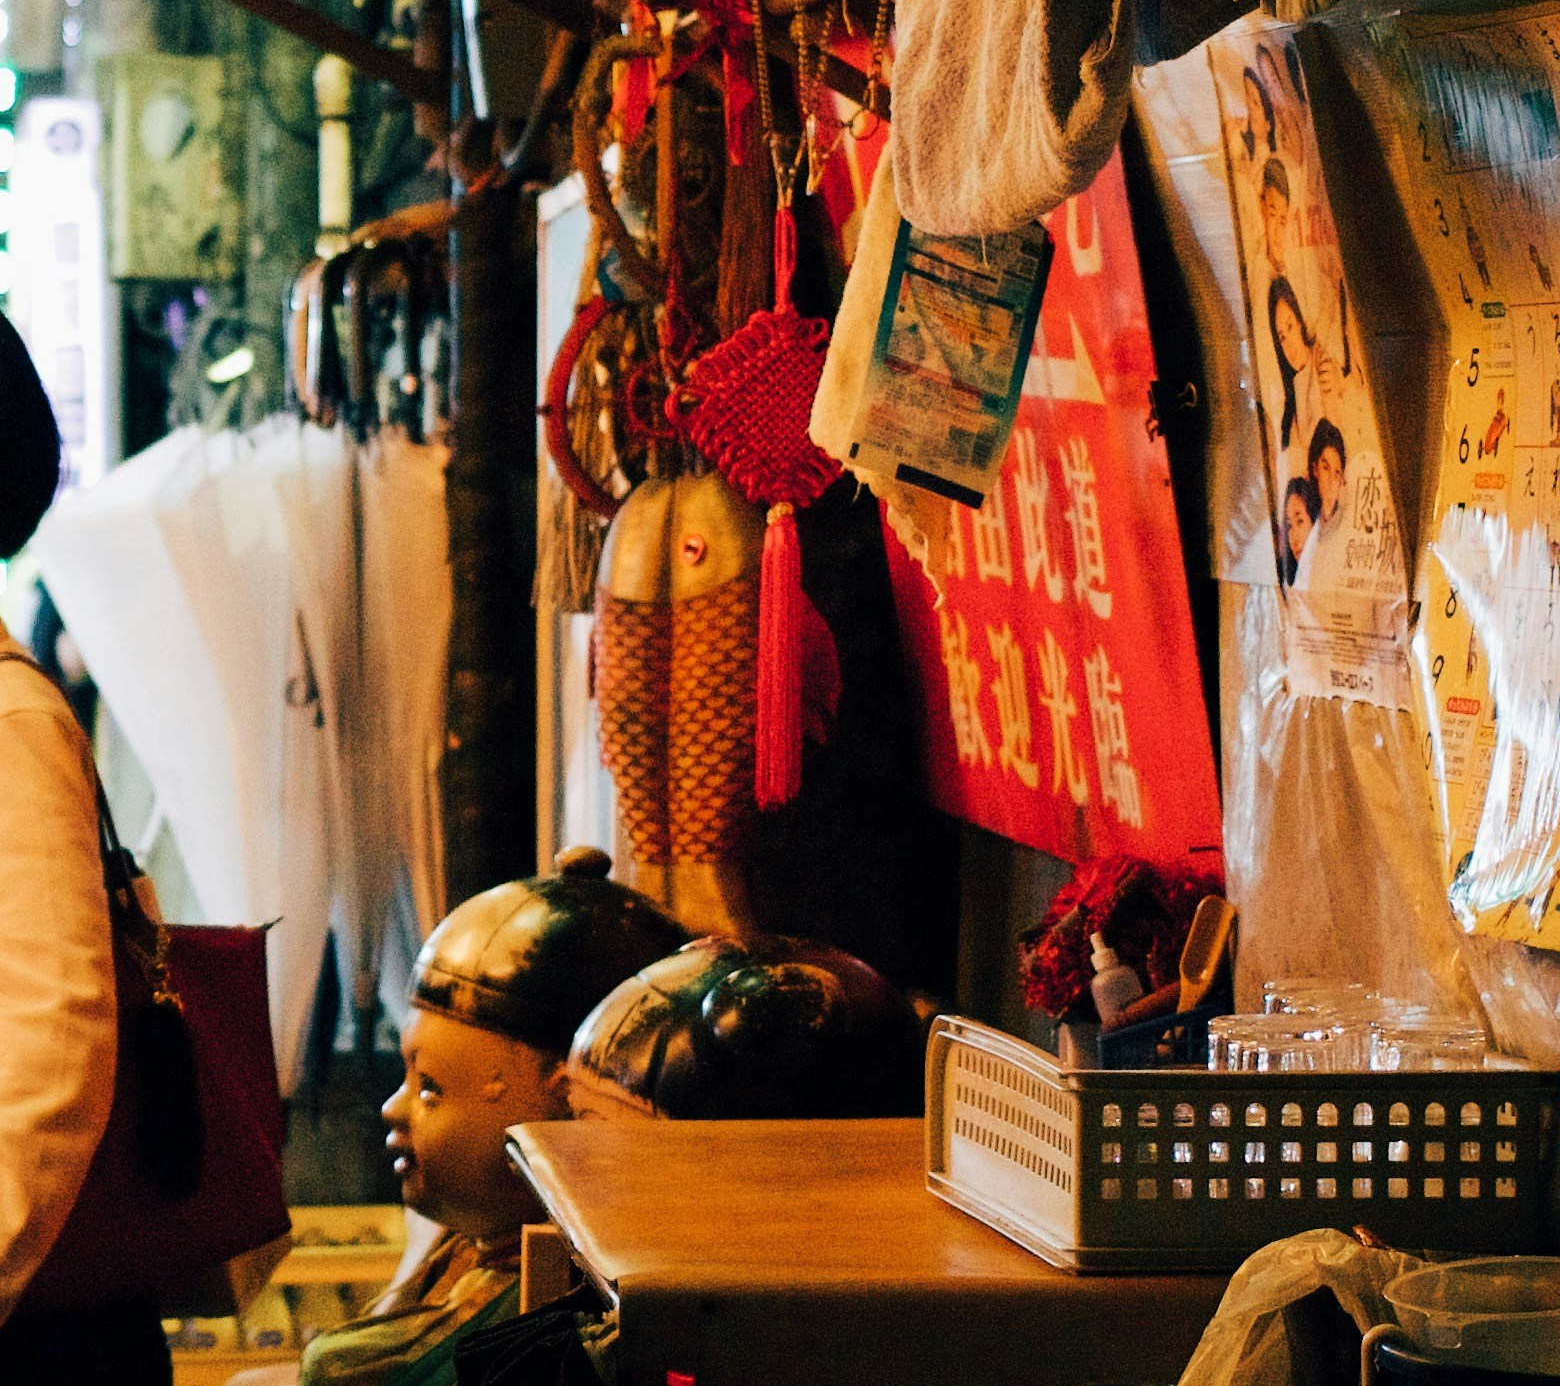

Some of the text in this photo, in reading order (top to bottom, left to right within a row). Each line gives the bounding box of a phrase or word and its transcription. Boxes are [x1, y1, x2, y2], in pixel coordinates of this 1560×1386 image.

[1433, 197, 1451, 237] 3
[1457, 272, 1474, 310] 4
[1466, 348, 1480, 388] 5
[1458, 423, 1470, 465] 6
[1444, 579, 1460, 619] 8
[1432, 654, 1444, 684] 9
